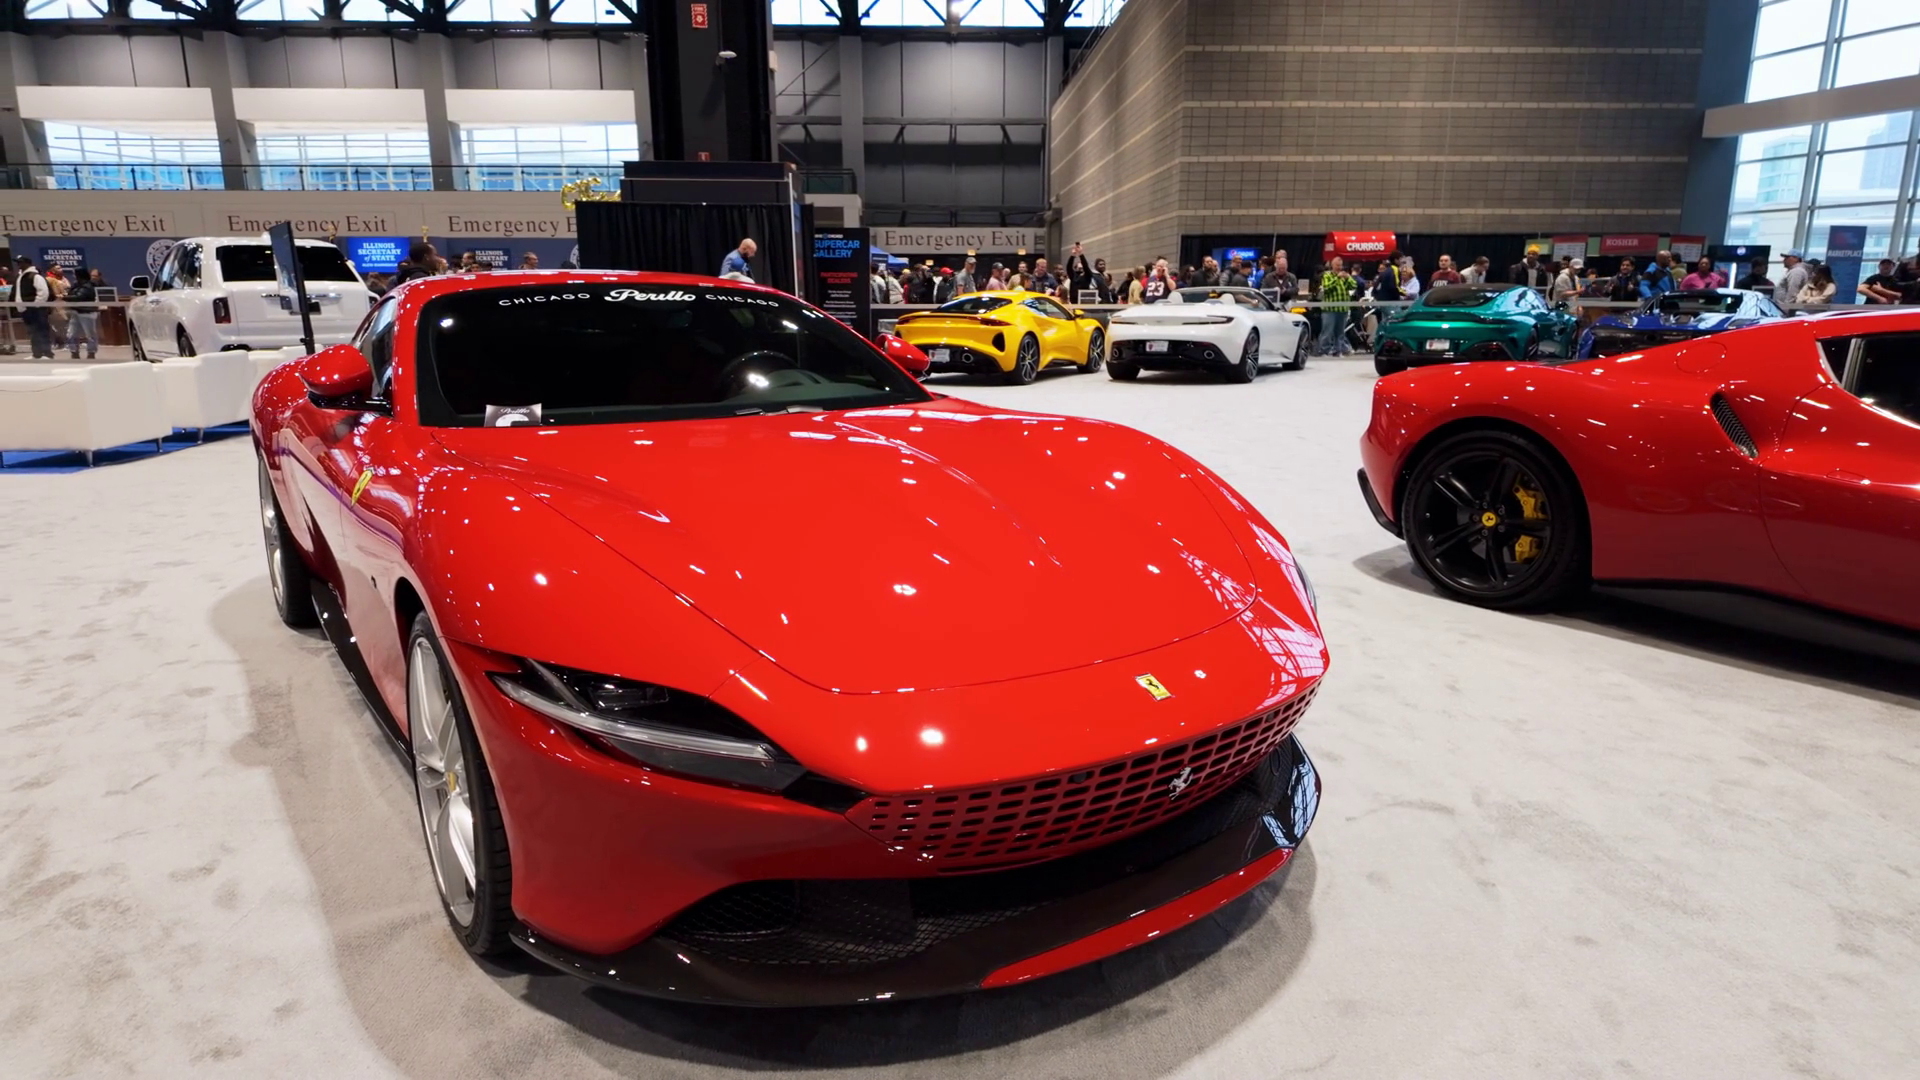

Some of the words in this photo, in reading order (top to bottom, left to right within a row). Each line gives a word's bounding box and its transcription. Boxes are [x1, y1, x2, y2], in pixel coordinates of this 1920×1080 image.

[2, 214, 118, 236] Emergency
[124, 214, 166, 232] Exit
[227, 215, 340, 236] Emeency
[346, 215, 388, 232] Exit
[448, 215, 560, 237] Emergency
[884, 230, 986, 250] Emergency
[991, 230, 1027, 246] Exit
[1346, 242, 1385, 251] CHURROS
[1606, 238, 1639, 247] KOSHER
[499, 293, 591, 306] CHICAGO
[604, 288, 696, 302] Perillo
[705, 294, 779, 307] CHICAGO
[1146, 281, 1165, 296] 23
